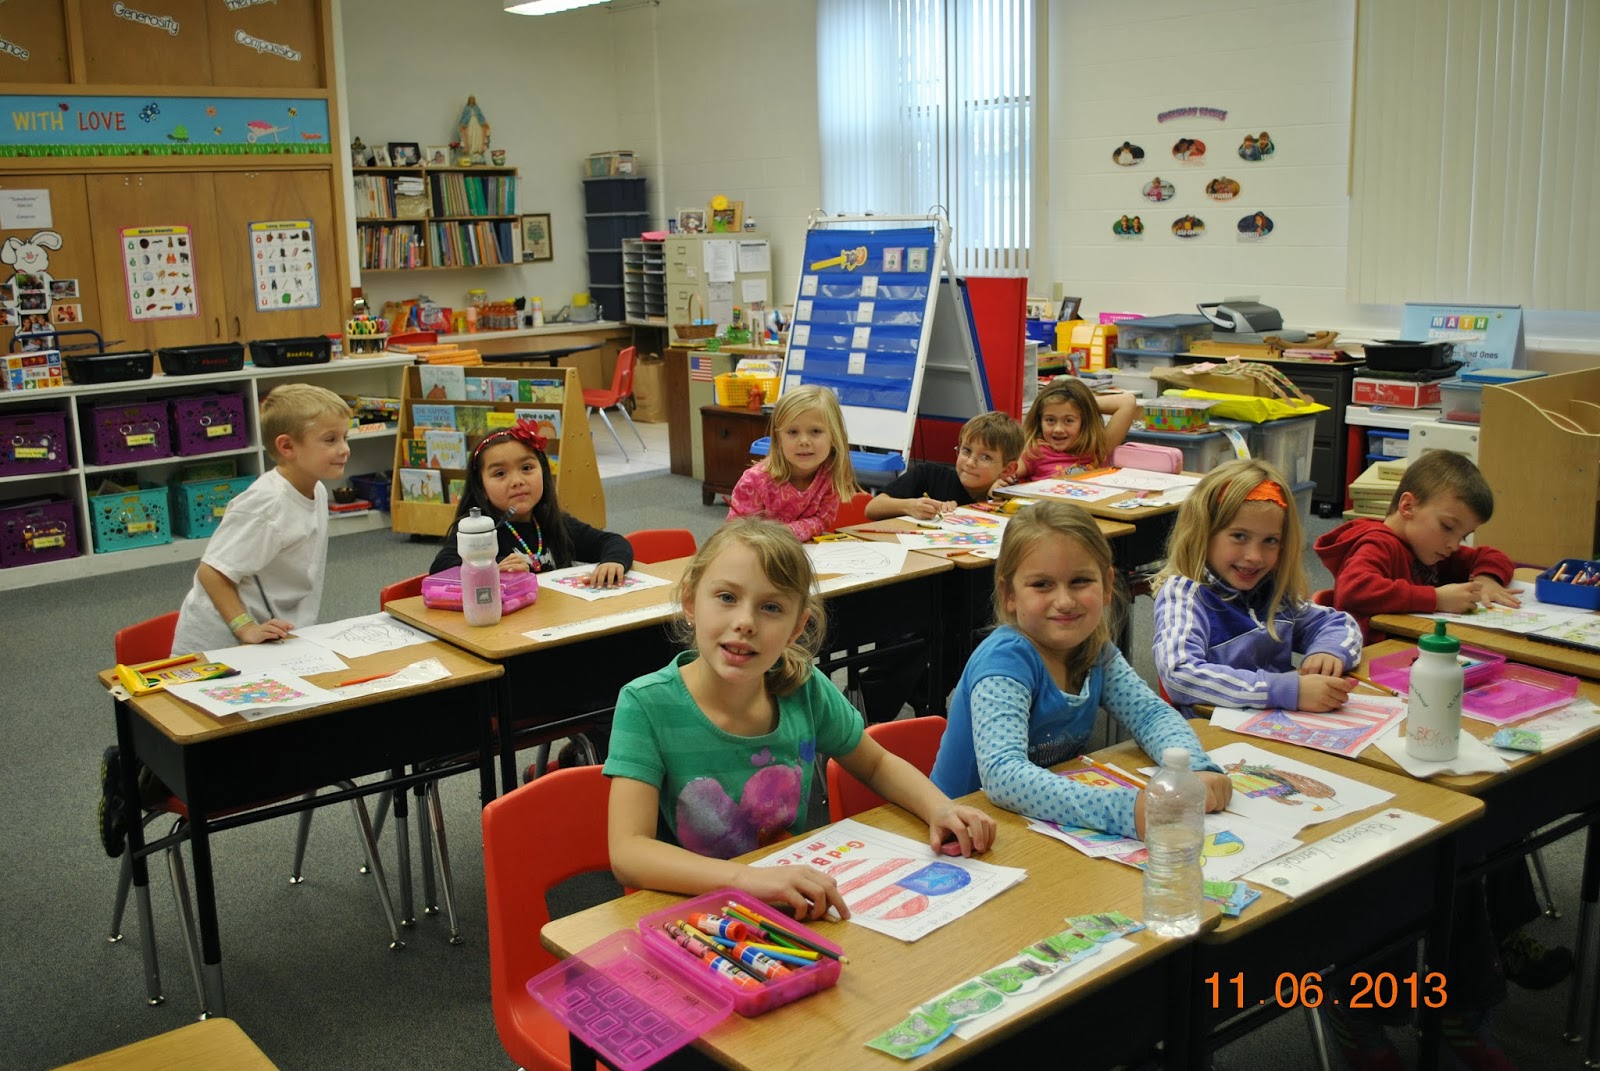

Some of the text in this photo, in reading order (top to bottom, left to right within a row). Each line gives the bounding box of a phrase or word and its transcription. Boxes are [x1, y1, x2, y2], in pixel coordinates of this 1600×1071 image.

[114, 2, 179, 35] Generosity
[235, 30, 300, 60] Compassion
[12, 111, 126, 131] WITH LOVE
[1432, 316, 1485, 329] MATH
[286, 350, 314, 359] Reading
[1479, 351, 1498, 360] Ones
[1330, 820, 1397, 845] Rebecca
